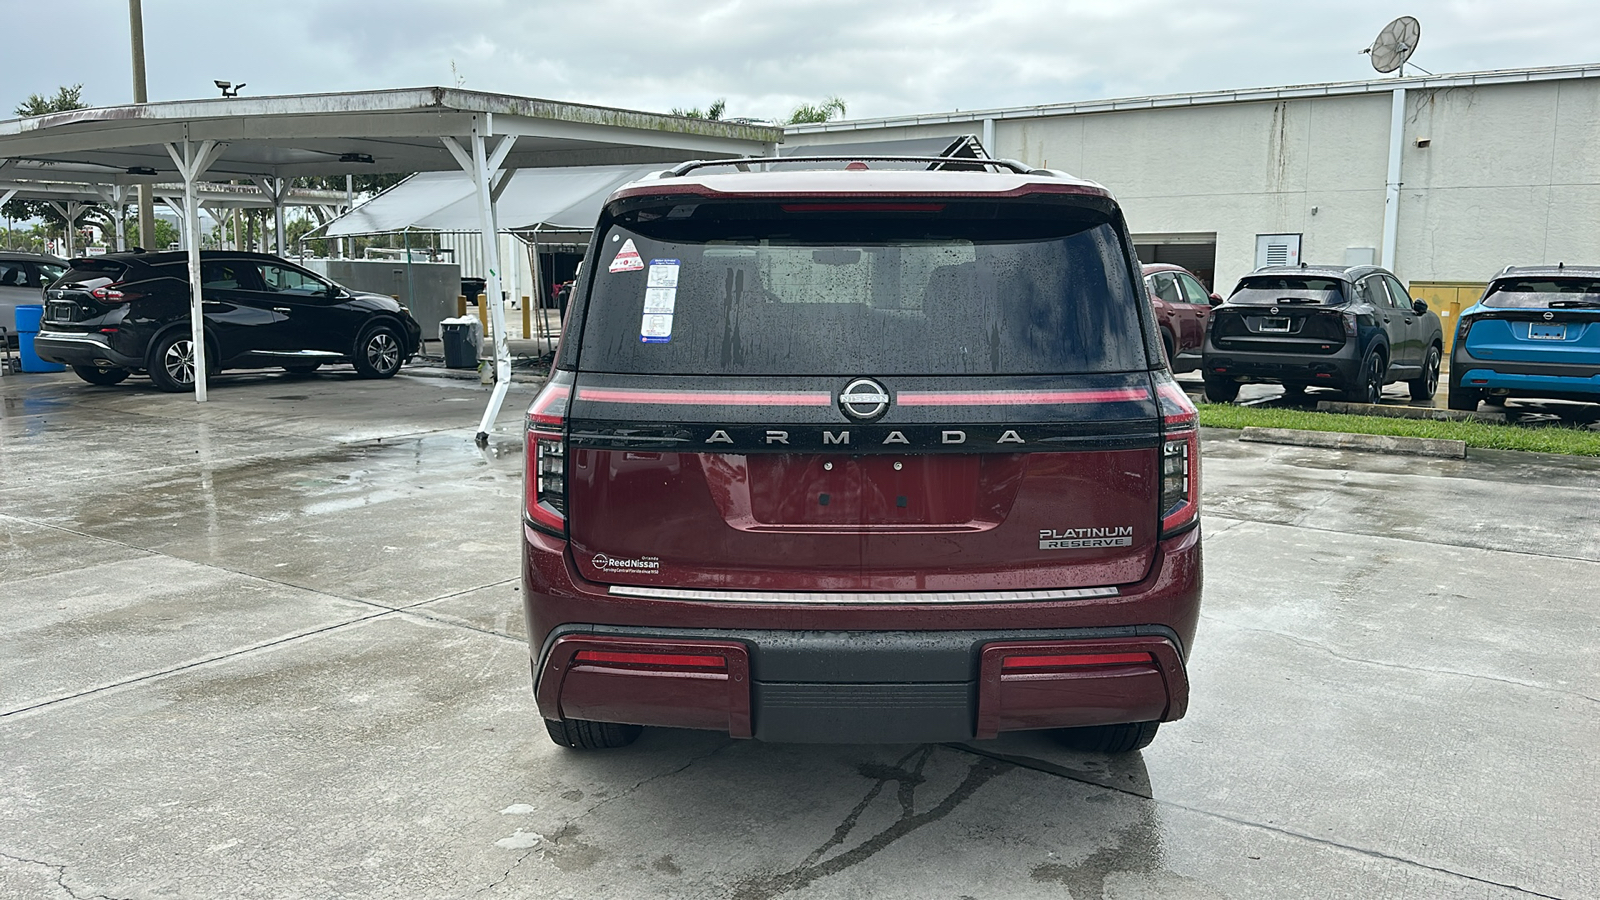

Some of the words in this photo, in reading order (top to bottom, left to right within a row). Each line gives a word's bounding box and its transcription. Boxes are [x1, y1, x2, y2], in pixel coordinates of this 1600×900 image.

[841, 395, 889, 404] NISSAN
[705, 430, 1026, 444] ARMADA
[1039, 526, 1132, 538] PLATINUM
[1048, 539, 1124, 547] RESERVE
